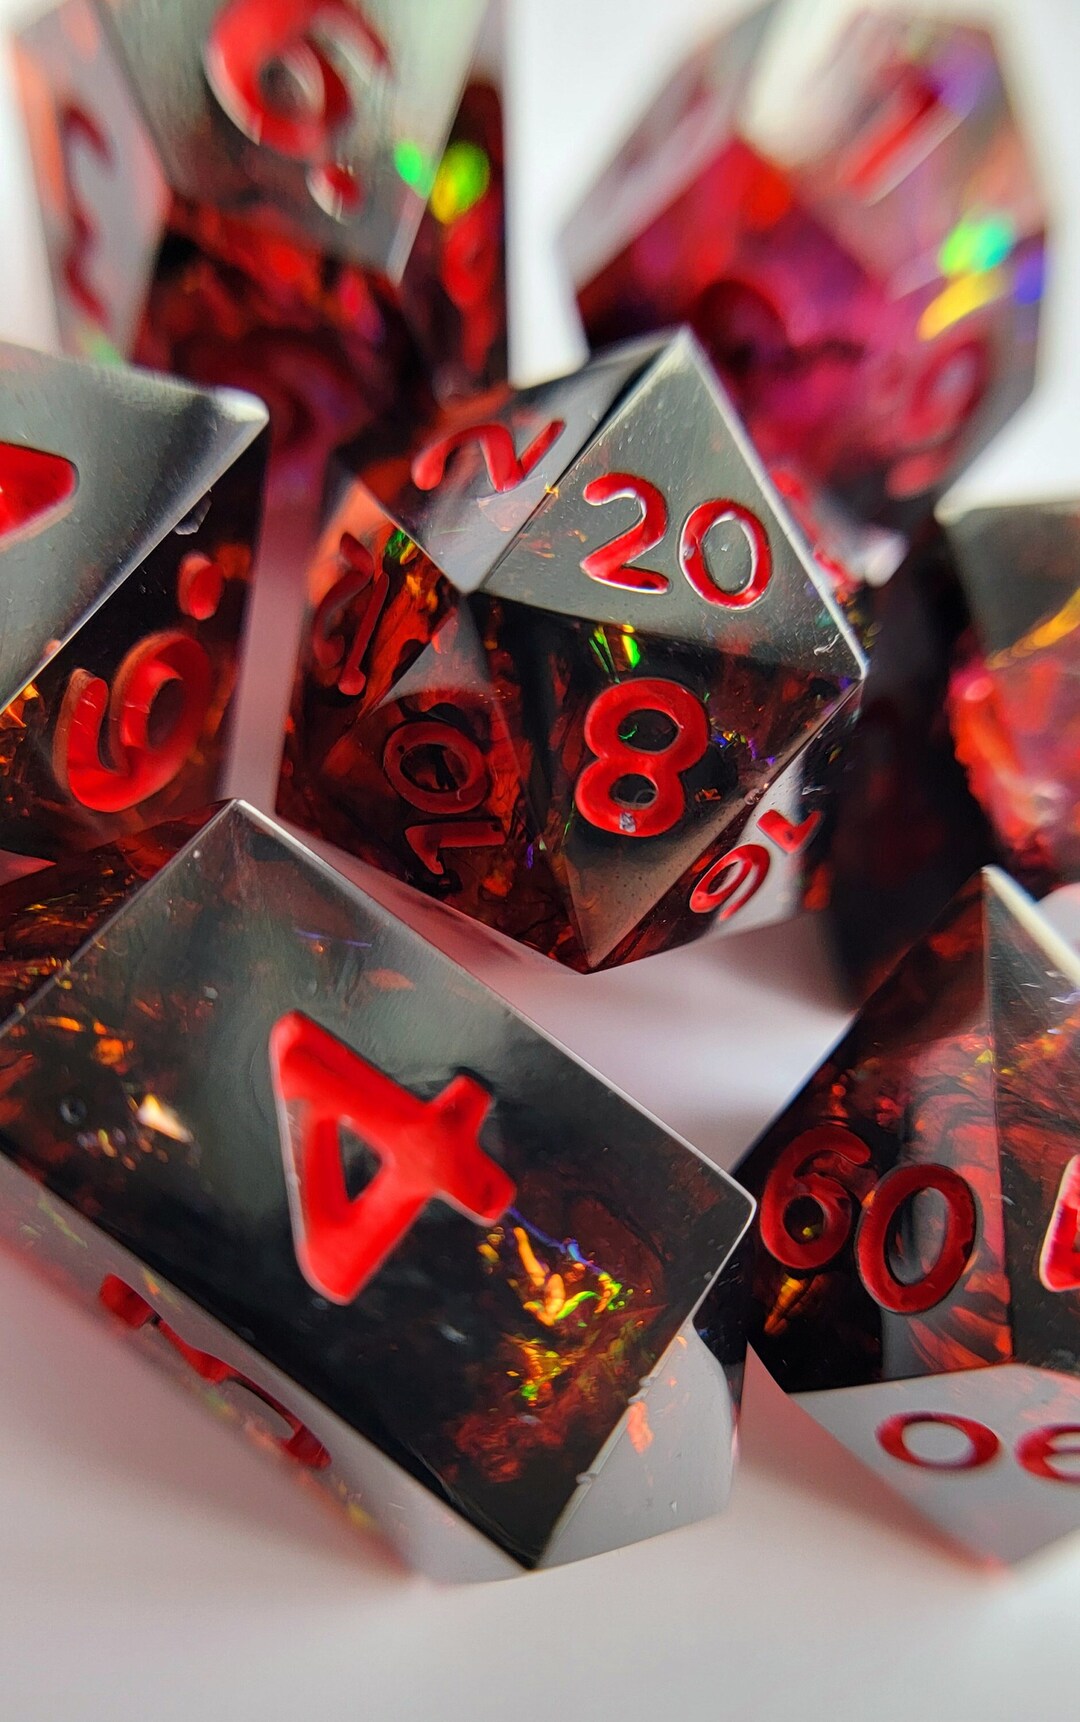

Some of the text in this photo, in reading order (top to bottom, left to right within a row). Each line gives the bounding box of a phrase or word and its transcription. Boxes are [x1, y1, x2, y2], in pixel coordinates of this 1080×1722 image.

[411, 420, 565, 492] 2
[312, 532, 390, 696] 12
[580, 473, 773, 610] 20
[383, 721, 504, 876] 10
[575, 678, 710, 837] 8
[690, 808, 823, 921] 16
[269, 1010, 516, 1306] 4
[759, 1126, 977, 1314] 60
